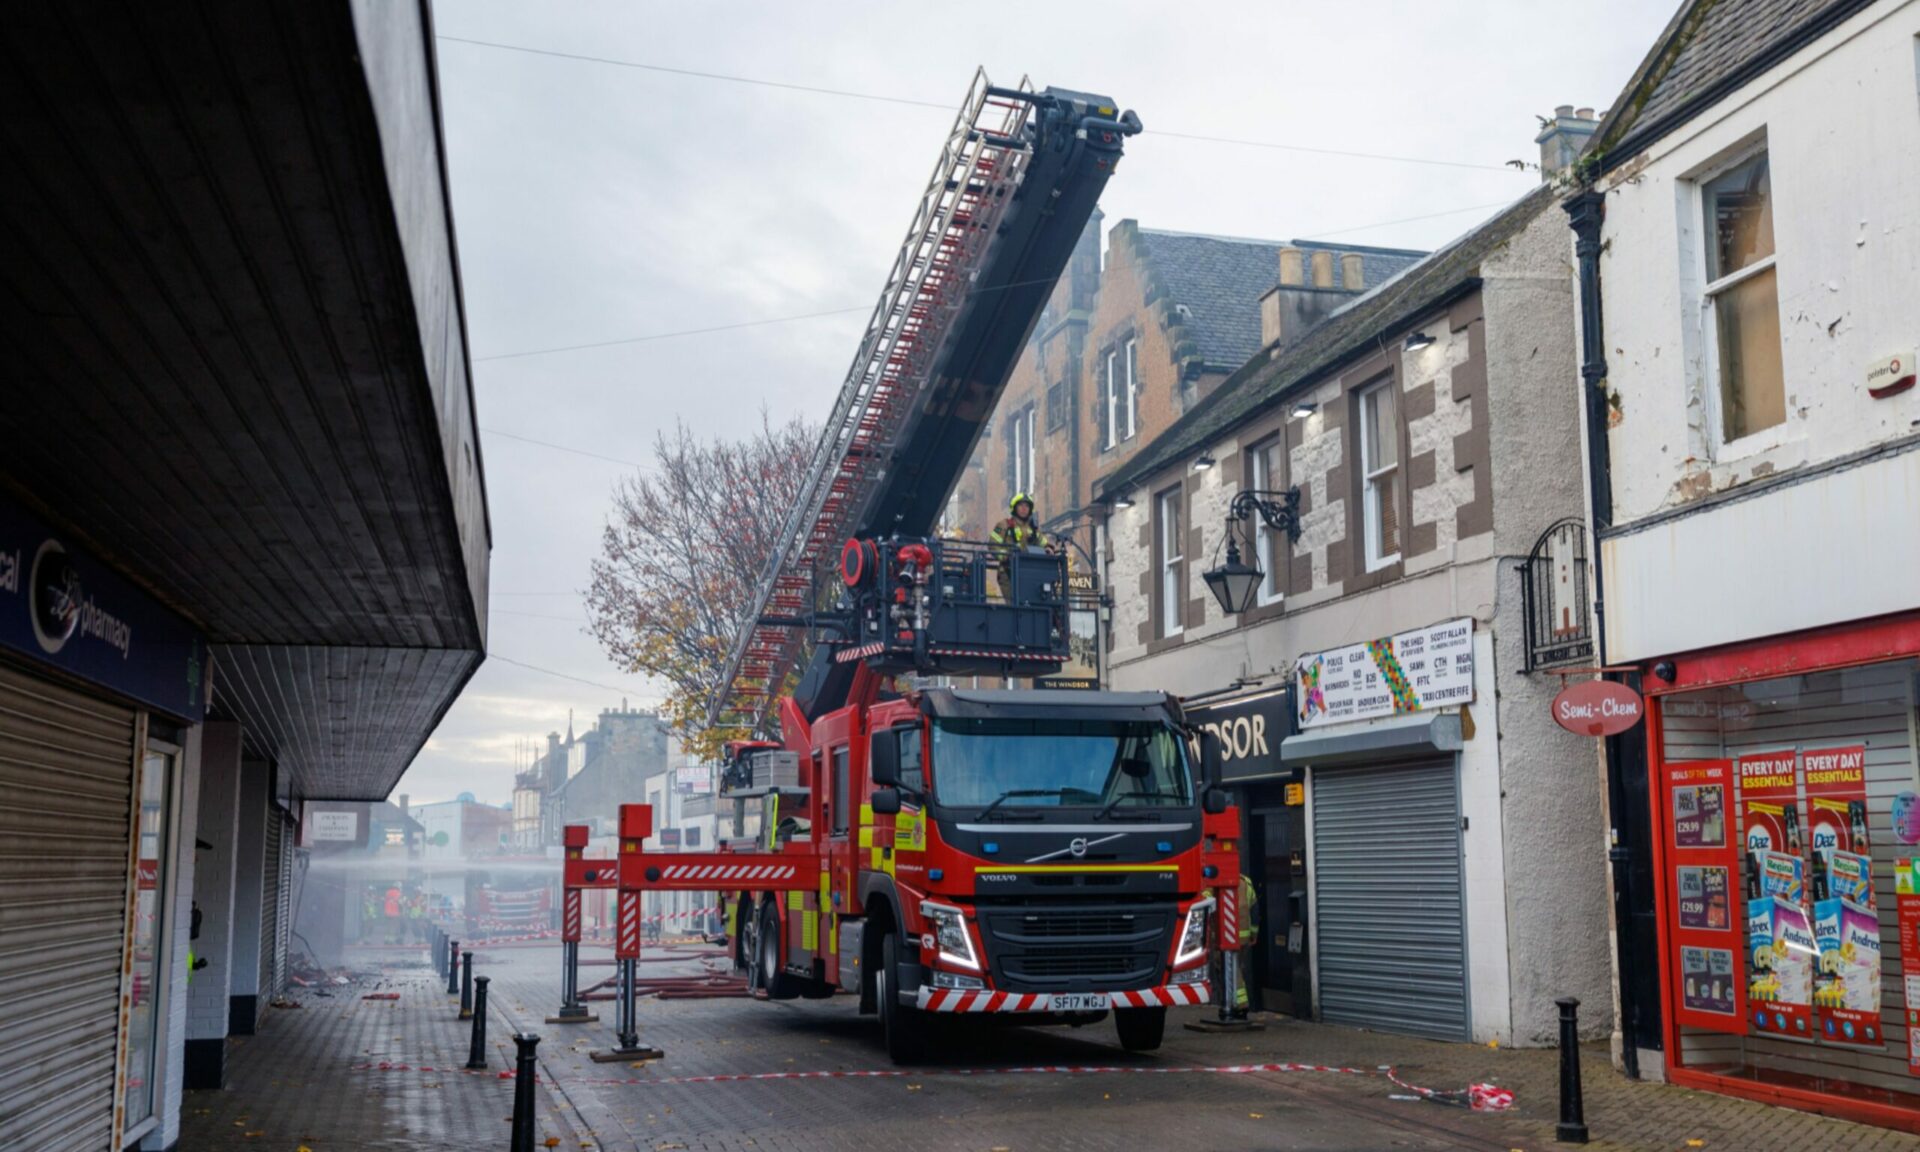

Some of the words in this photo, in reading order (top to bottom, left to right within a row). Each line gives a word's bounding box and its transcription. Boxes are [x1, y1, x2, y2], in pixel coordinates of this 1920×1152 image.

[81, 594, 131, 660] pharmacy
[1327, 656, 1343, 667] POLICE
[1434, 656, 1447, 668] CTH
[1044, 681, 1057, 689] THE
[1058, 681, 1090, 689] WINDSOR
[1435, 687, 1456, 700] CENTRE
[1456, 685, 1469, 697] FIFE
[1742, 761, 1773, 776] EVERY
[1775, 759, 1794, 774] DAY
[1805, 755, 1839, 771] EVERY
[1840, 753, 1861, 769] DAY
[1743, 775, 1794, 789] ESSENTIALS
[1807, 770, 1861, 784] ESSENTIALS
[1748, 835, 1769, 850] Daz
[1814, 833, 1835, 849] Daz
[1767, 859, 1793, 874] Regina
[1834, 858, 1859, 873] Regina
[981, 874, 1017, 882] VOLVO
[1851, 930, 1880, 950] Andrex
[1055, 996, 1080, 1008] SF17
[1083, 996, 1105, 1008] WGJ
